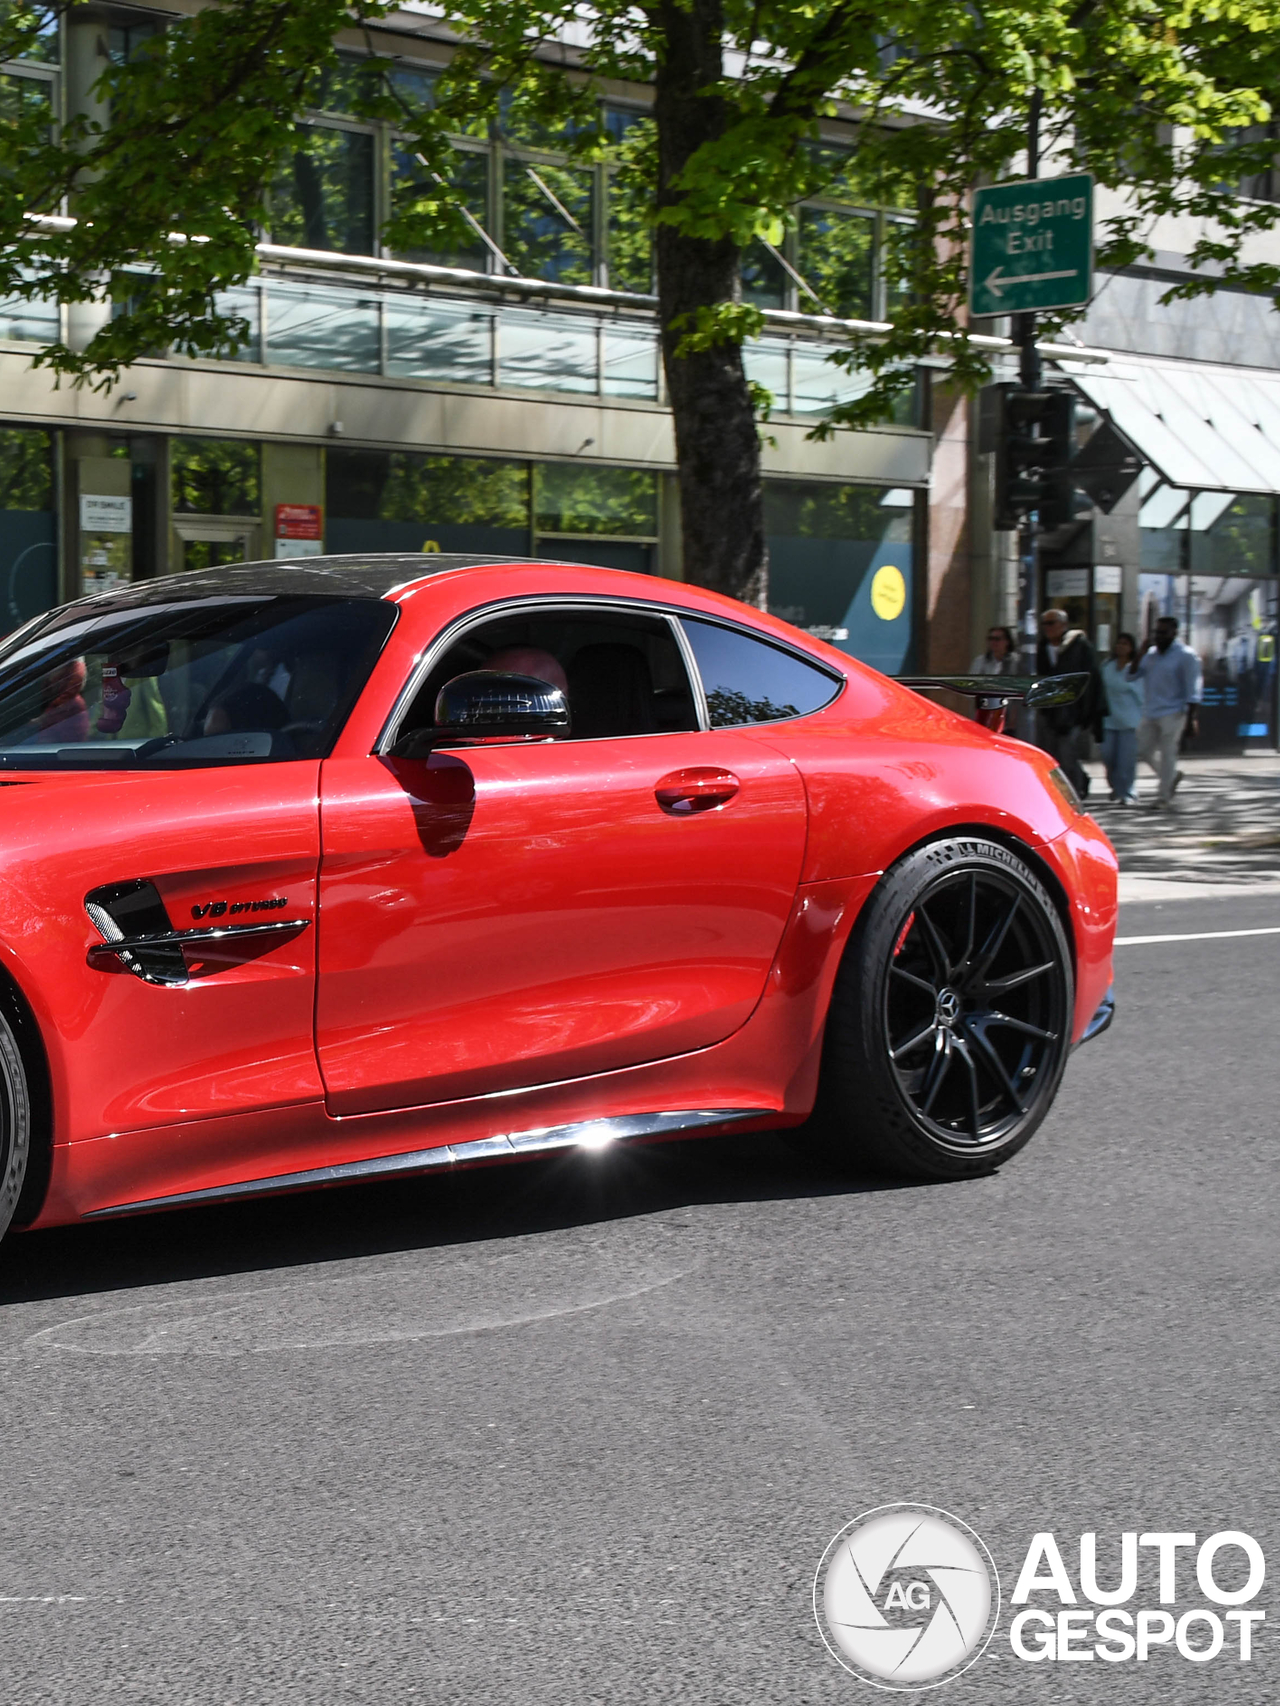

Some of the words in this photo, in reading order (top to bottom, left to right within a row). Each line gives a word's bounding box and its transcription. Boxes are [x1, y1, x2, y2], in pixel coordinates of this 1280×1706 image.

[978, 197, 1086, 226] Ausgang
[1005, 229, 1055, 255] Exit
[976, 843, 1038, 892] MICHELIN
[190, 900, 227, 920] V8
[229, 897, 288, 915] BITURBO
